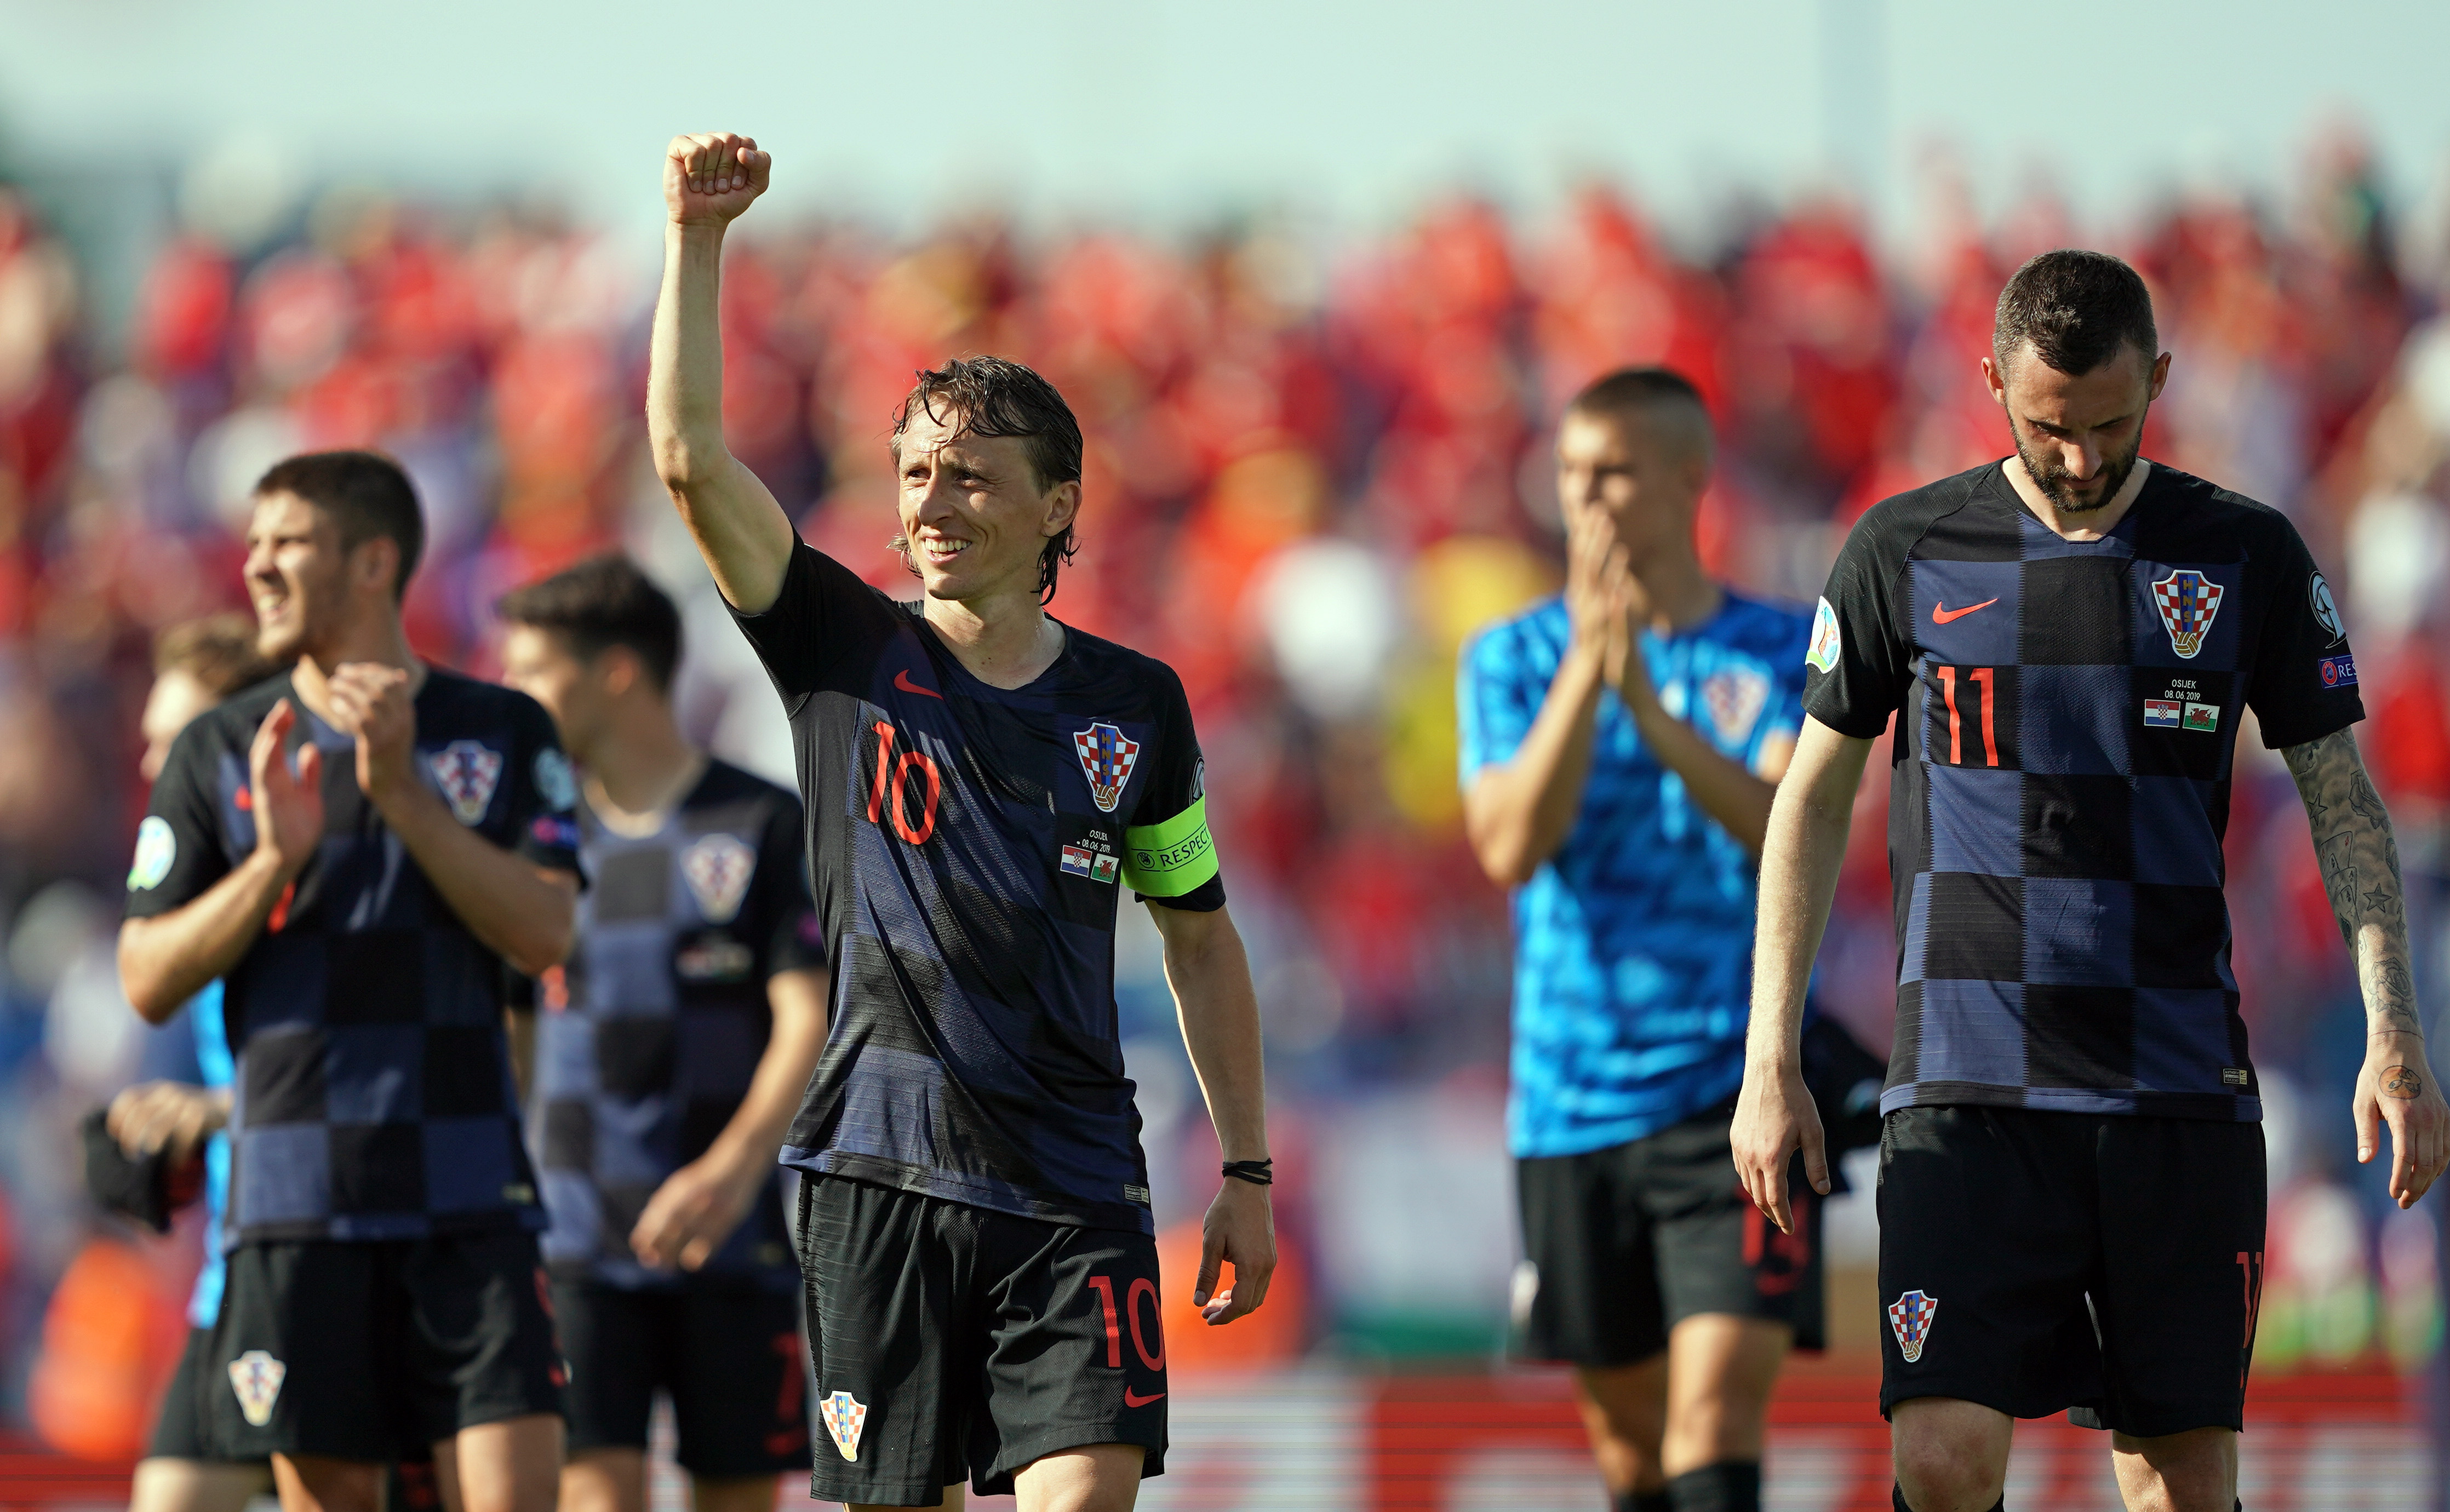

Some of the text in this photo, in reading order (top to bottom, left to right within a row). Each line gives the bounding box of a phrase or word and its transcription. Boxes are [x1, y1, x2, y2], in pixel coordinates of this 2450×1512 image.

[2183, 579, 2193, 623] HNS
[2171, 679, 2197, 689] OSIJEK
[1937, 666, 1999, 766] 11
[1101, 733, 1112, 776] HNS
[867, 720, 941, 845] 10
[1089, 829, 1108, 841] OSIJEK
[1160, 826, 1210, 867] RESPECT
[1088, 1275, 1165, 1372] 10
[838, 1399, 847, 1436] HNS
